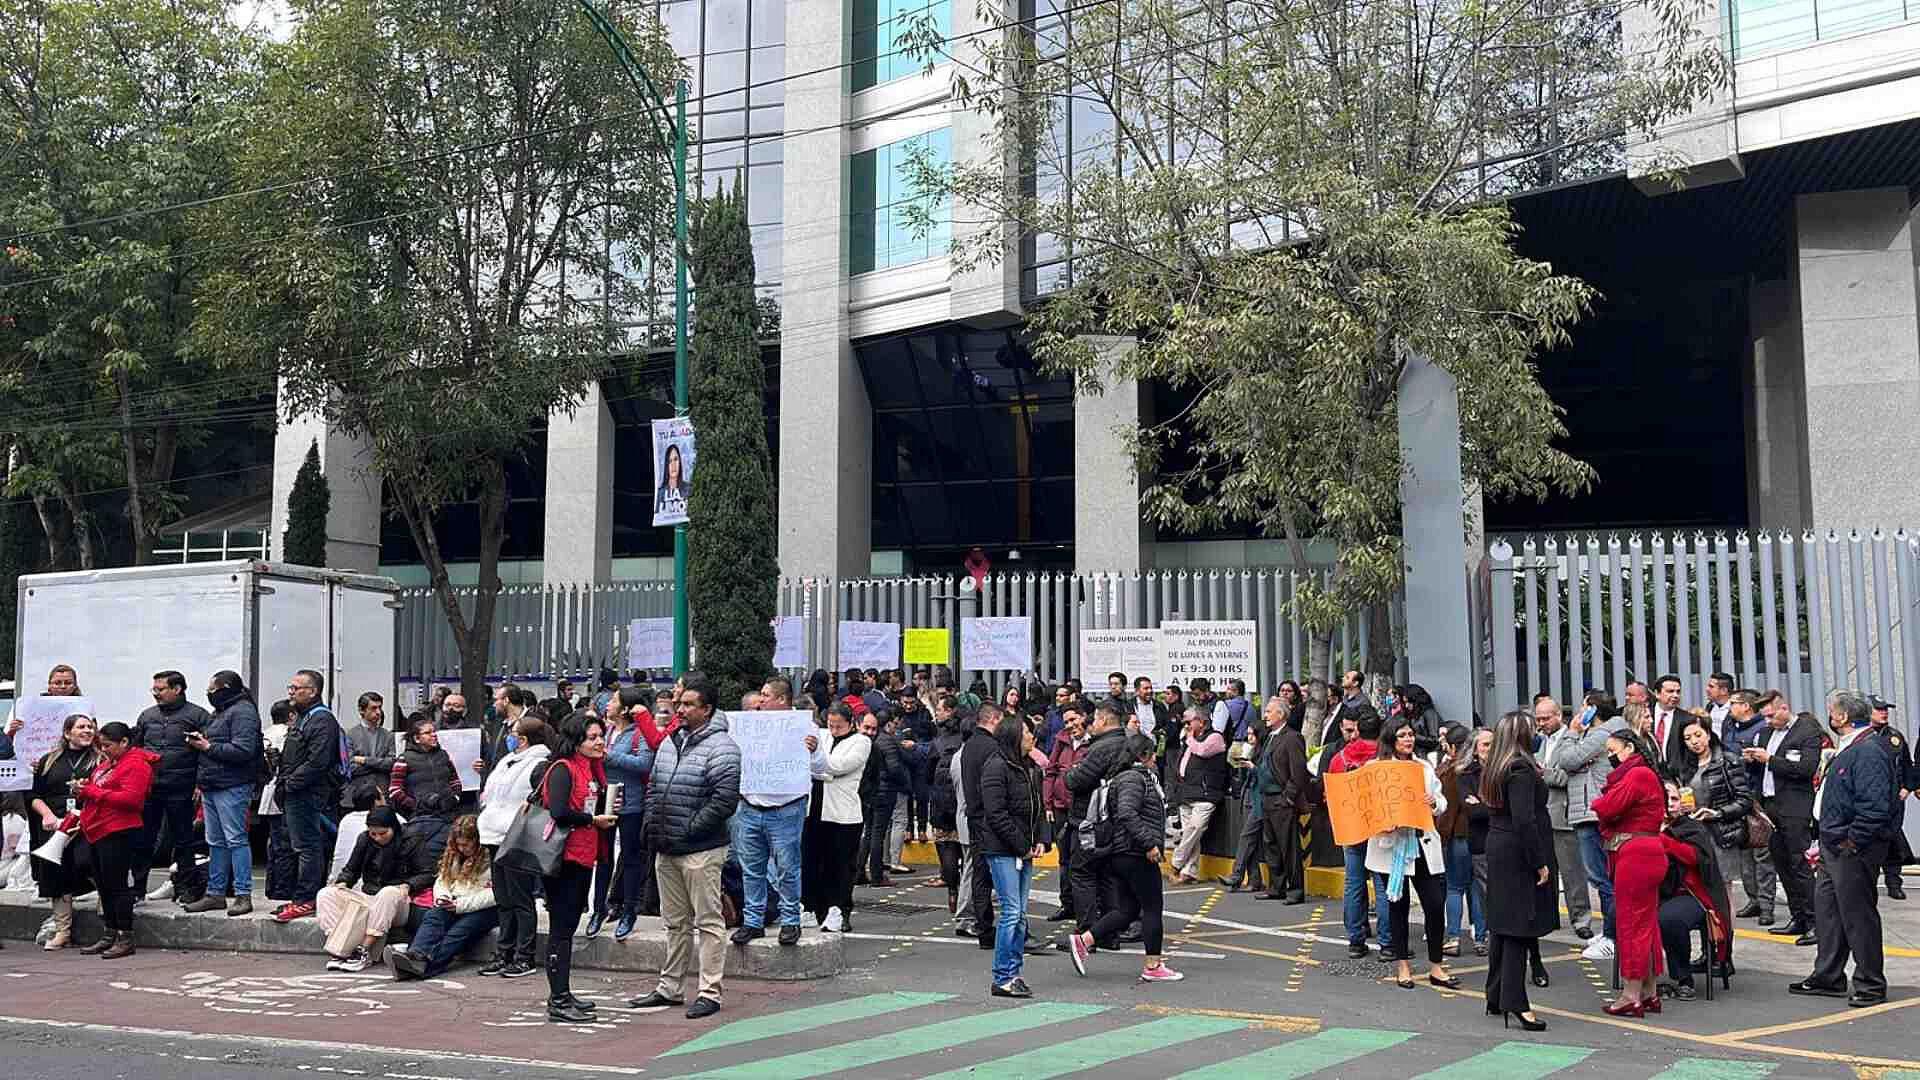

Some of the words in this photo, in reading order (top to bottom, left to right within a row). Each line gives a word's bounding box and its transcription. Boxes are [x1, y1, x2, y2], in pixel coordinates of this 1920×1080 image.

[1164, 627, 1199, 637] HORARIO
[1200, 627, 1211, 637] DE
[1117, 635, 1154, 643] JUDICIAL
[1187, 639, 1197, 648] AL
[1168, 651, 1178, 660] DE
[1180, 651, 1206, 660] LUNES
[1207, 651, 1214, 660] A
[1214, 650, 1249, 660] VIERNES
[1171, 664, 1188, 673] DE
[1190, 664, 1216, 673] 9:30
[1219, 664, 1248, 673] HRS.
[1171, 677, 1180, 686] A
[1342, 784, 1416, 814] SOMOS
